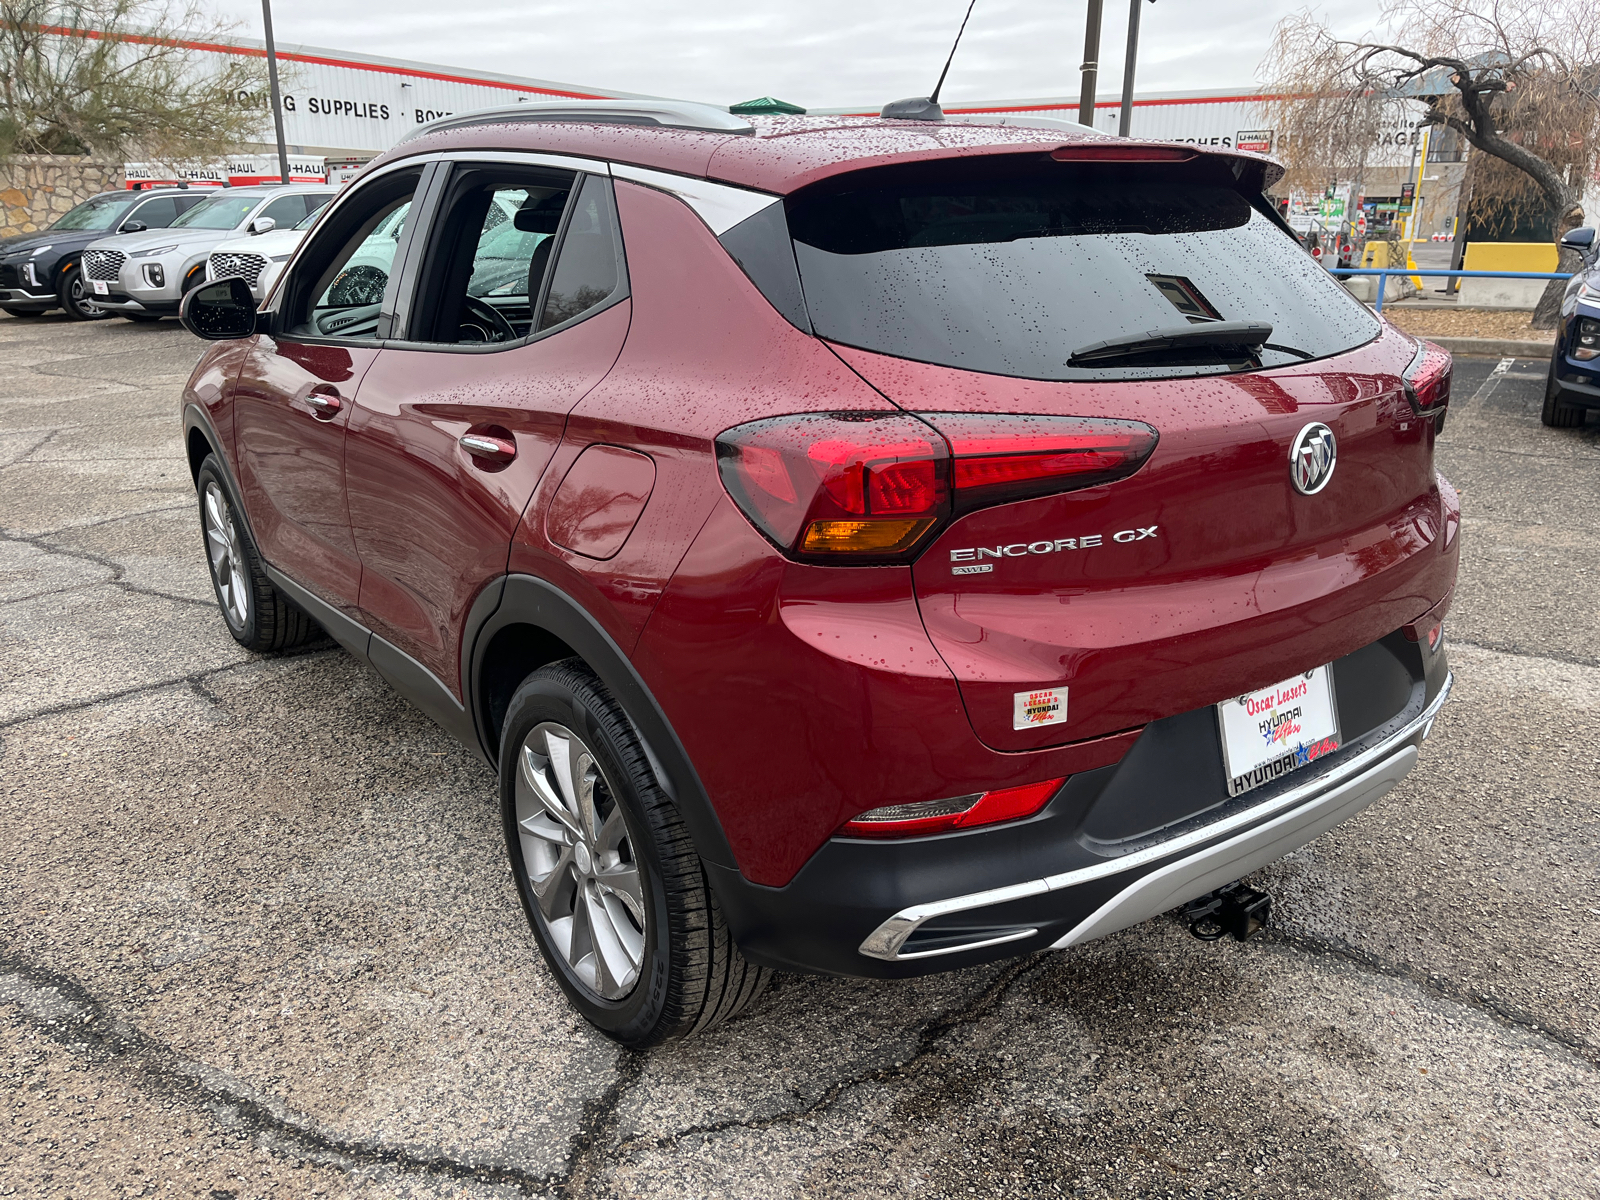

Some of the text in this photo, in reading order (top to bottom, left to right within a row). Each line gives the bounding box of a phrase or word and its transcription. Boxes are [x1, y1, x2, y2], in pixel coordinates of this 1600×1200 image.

[308, 97, 390, 120] SUPPLIES
[1239, 133, 1269, 141] U-HAUL
[1241, 143, 1265, 151] CENTER
[178, 170, 222, 180] U-HAUL
[950, 525, 1158, 562] ENCORE GX
[953, 565, 993, 575] AWD
[1029, 691, 1053, 700] OSCAR
[1246, 680, 1307, 716] Oscar Leeser's
[1024, 697, 1058, 707] LEESER'S
[1027, 704, 1059, 715] HYUNDAI
[1258, 706, 1302, 733] HYUNDAI
[1234, 753, 1296, 794] HYUNDAI
